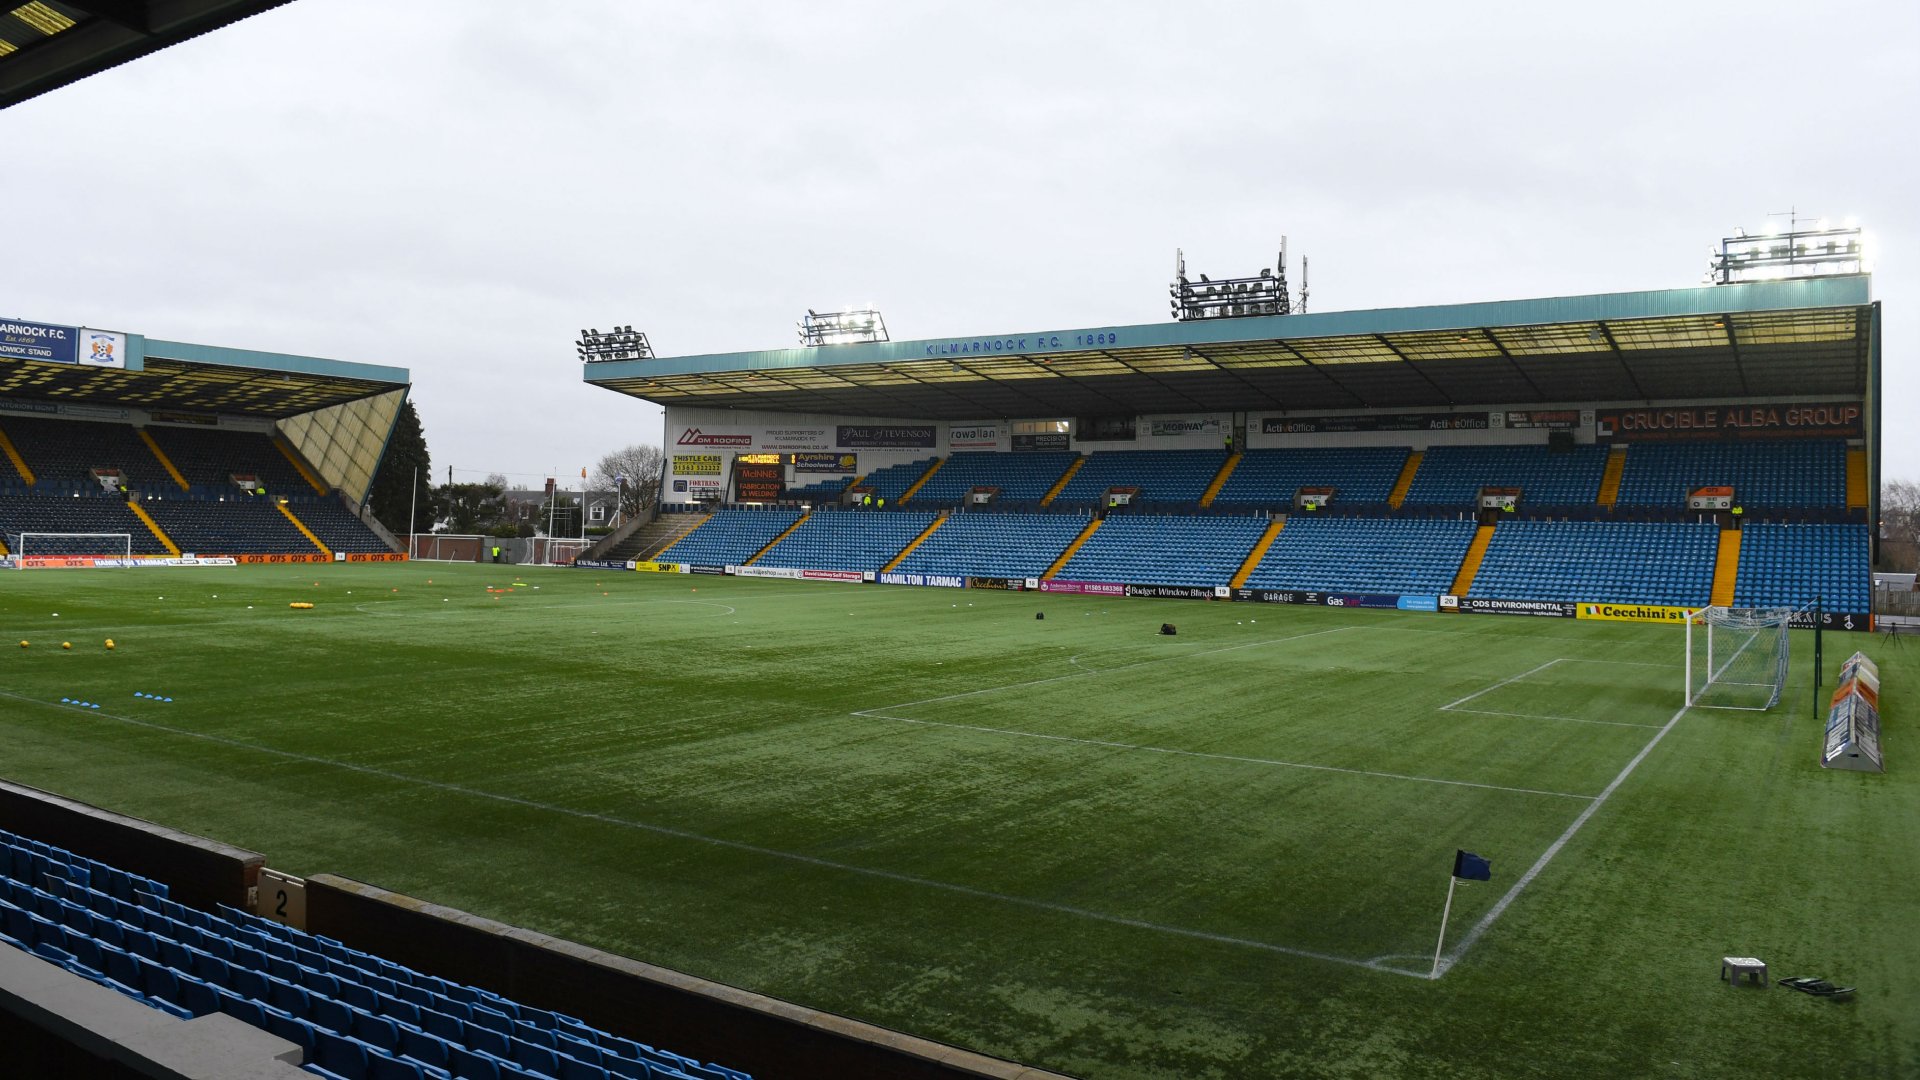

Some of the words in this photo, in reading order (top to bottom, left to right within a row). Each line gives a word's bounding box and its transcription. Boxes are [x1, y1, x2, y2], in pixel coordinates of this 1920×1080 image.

[0, 324, 46, 337] ARNOCK
[49, 330, 66, 339] F.C.
[926, 338, 1026, 355] KILMARNOCK
[1076, 333, 1116, 345] 1869
[28, 348, 52, 356] STAND
[1622, 410, 1717, 430] CRUCIBLE
[1723, 409, 1780, 428] ALBA
[1786, 406, 1860, 426] GROUP
[842, 428, 870, 440] PAUL
[951, 428, 994, 438] rowallan
[742, 470, 778, 478] McINNES
[248, 555, 264, 563] OTS
[270, 555, 286, 563] OTS
[881, 573, 923, 586] HAMILTON
[926, 576, 961, 587] TARMAC
[1132, 587, 1156, 596] Budget
[1158, 588, 1188, 596] Window
[1190, 589, 1214, 598] Blinds
[1264, 592, 1293, 602] GARAGE
[1492, 601, 1562, 611] ENVIRONMENTAL
[1603, 606, 1676, 619] Cecchini's
[276, 890, 287, 917] 2
